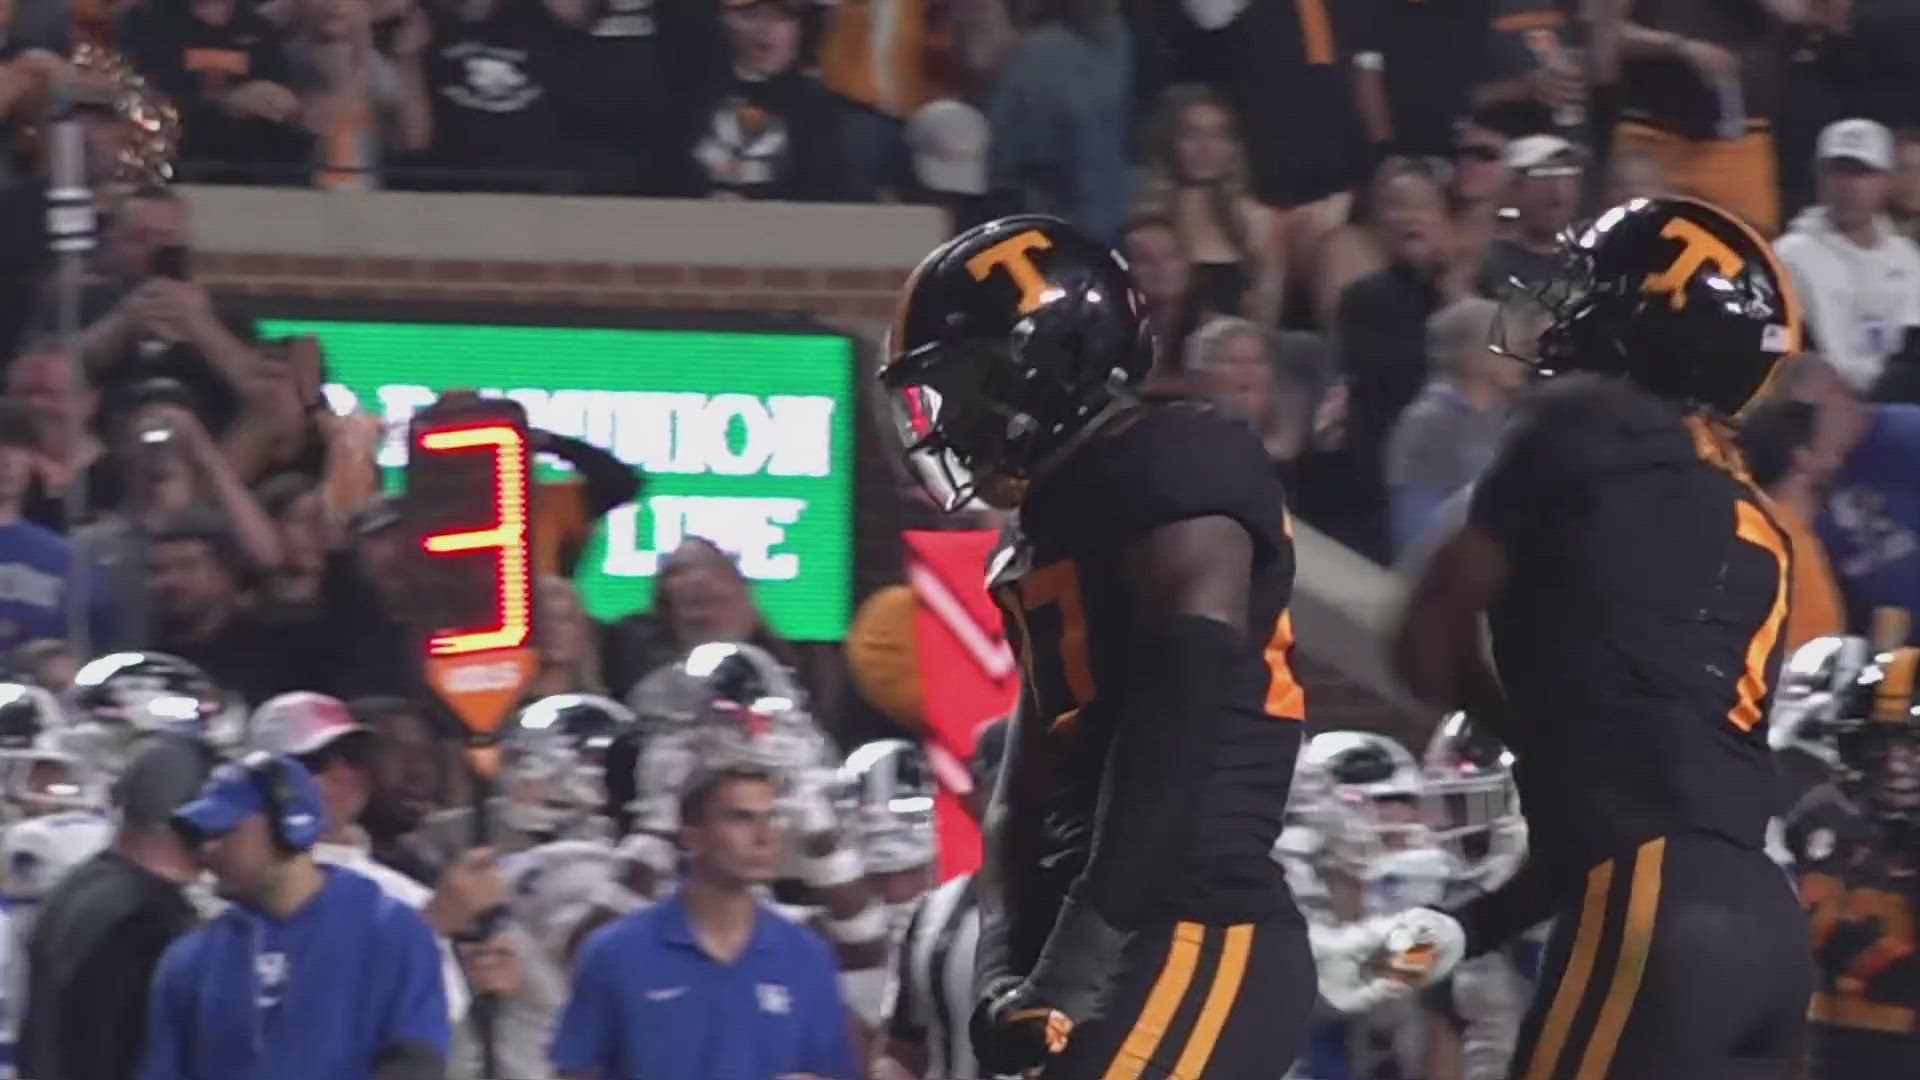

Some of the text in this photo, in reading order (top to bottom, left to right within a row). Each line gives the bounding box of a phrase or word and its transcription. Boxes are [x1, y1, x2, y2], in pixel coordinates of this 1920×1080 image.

[965, 229, 1062, 314] T
[1640, 216, 1745, 312] T
[419, 424, 531, 656] 3
